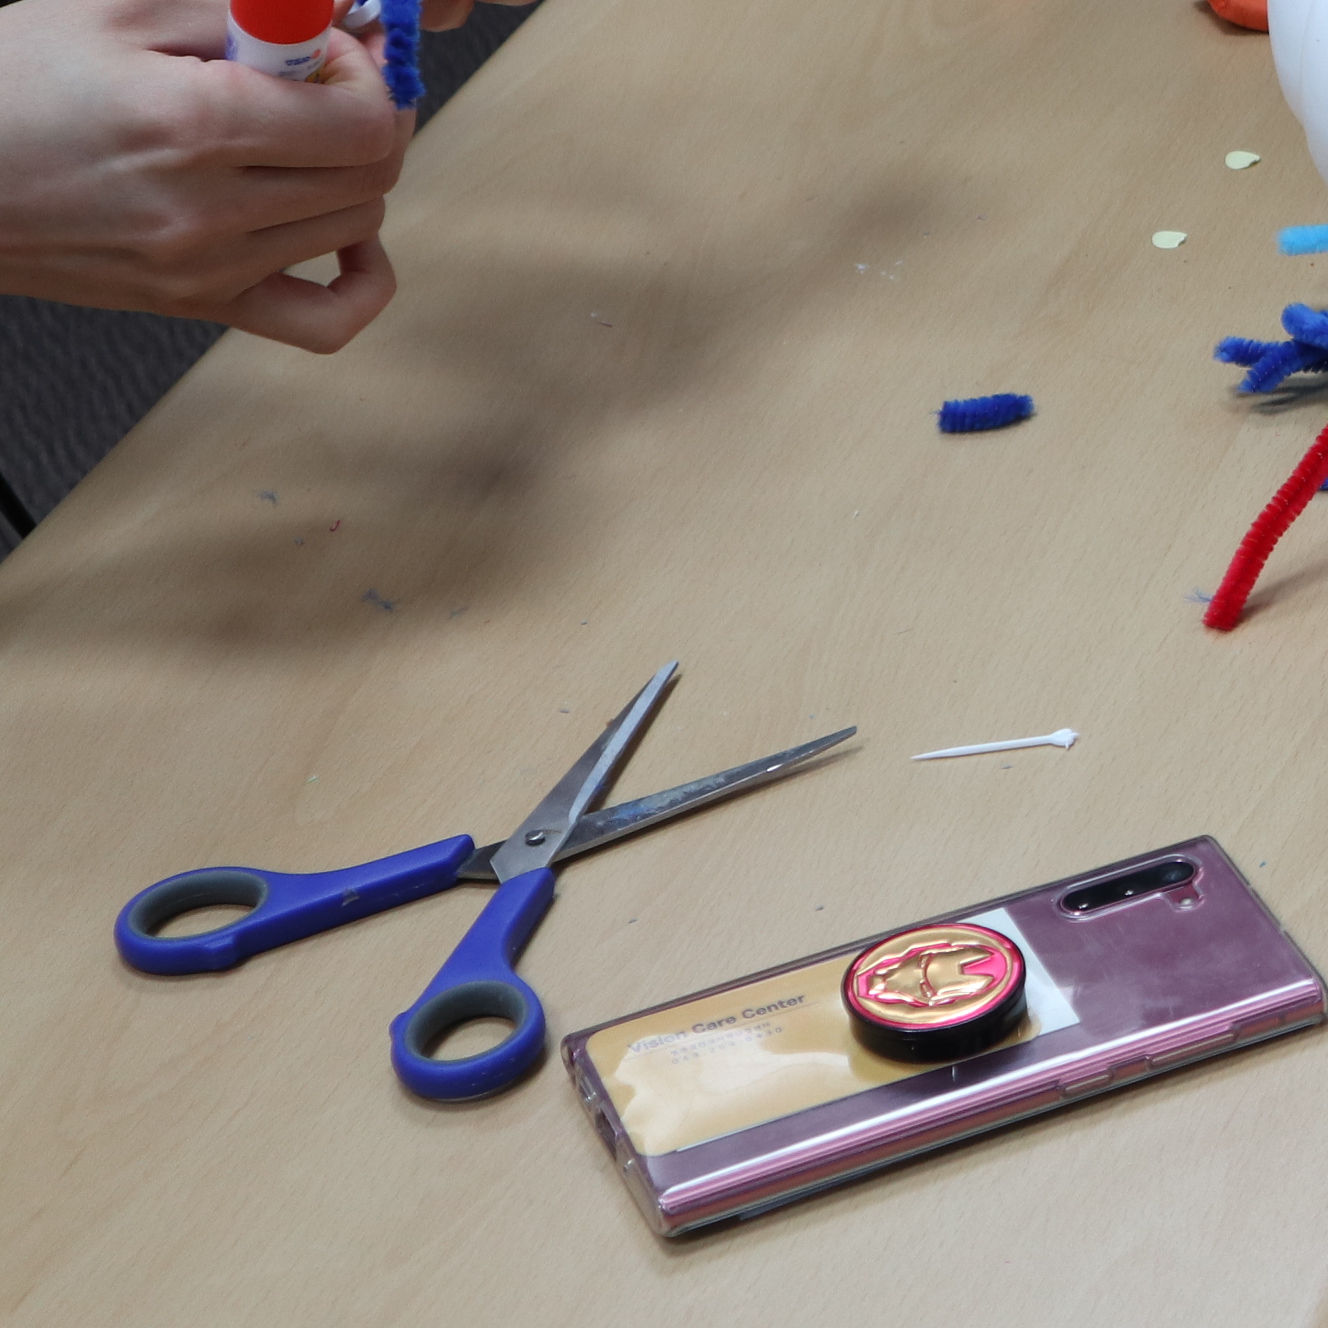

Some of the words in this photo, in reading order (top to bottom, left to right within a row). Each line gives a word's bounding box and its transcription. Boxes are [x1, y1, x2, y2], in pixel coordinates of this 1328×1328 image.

[628, 1030, 687, 1054] Vision
[691, 1015, 737, 1035] Care
[741, 994, 806, 1020] Center
